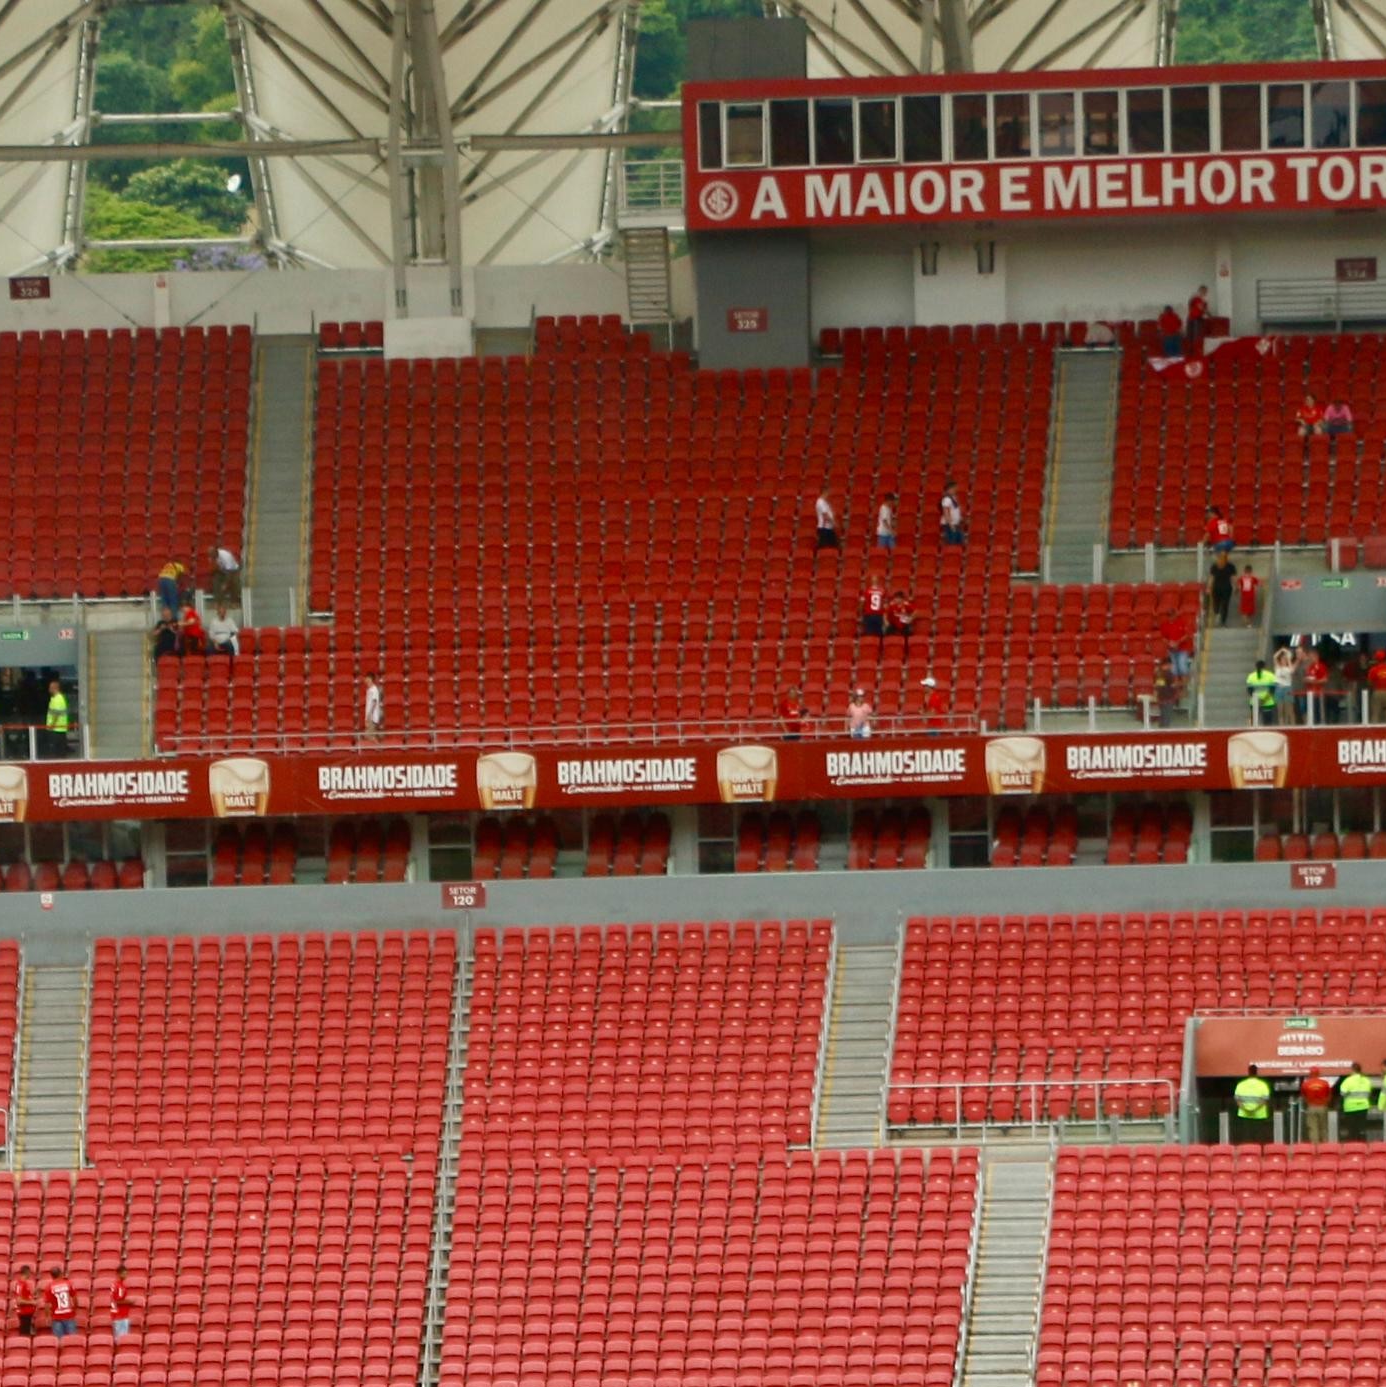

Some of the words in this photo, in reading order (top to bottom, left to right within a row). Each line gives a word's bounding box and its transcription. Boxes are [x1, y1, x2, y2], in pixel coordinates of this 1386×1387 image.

[750, 176, 787, 220] A
[804, 168, 985, 219] MAIOR
[999, 167, 1032, 212] E
[1043, 159, 1276, 211] MELHOR
[826, 748, 966, 776] BRAHMOSIDADE
[1066, 743, 1207, 770] BRAHMOSIDADE
[557, 757, 697, 784] BRAHMOSIDADE
[318, 764, 457, 790] BRAHMOSIDADE
[1000, 774, 1032, 785] MALTE
[48, 770, 189, 797] BRAHMOSIDADE
[732, 783, 763, 794] MALTE
[492, 789, 523, 800] MALTE
[225, 796, 255, 807] MALTE
[1298, 866, 1326, 876] SETOR
[1304, 876, 1323, 886] 119
[449, 887, 477, 895] SETOR
[453, 895, 474, 905] 120
[55, 1291, 69, 1309] 13
